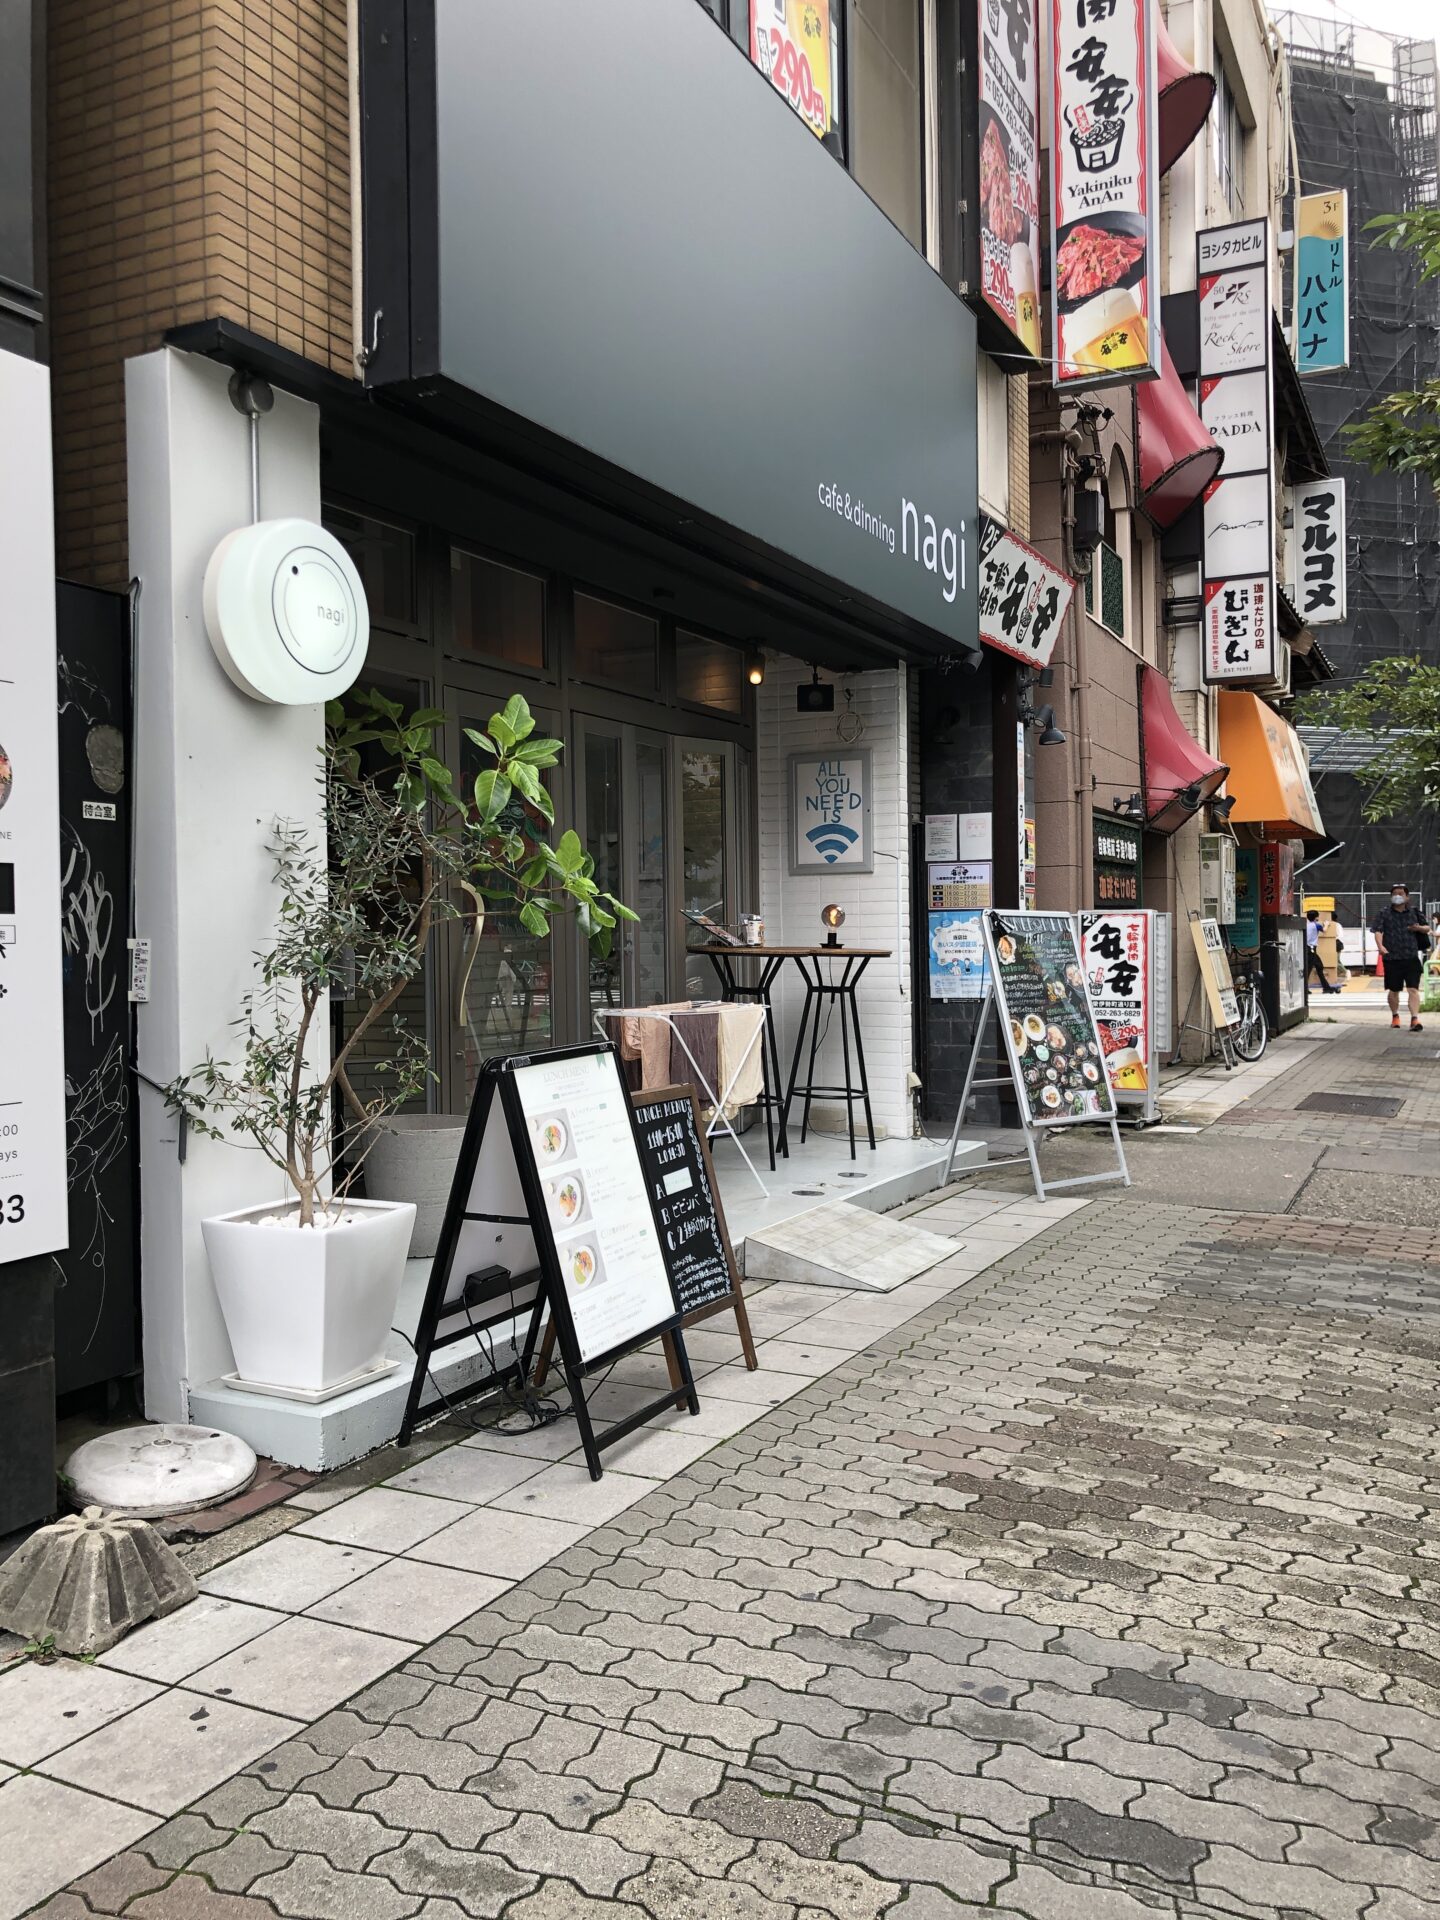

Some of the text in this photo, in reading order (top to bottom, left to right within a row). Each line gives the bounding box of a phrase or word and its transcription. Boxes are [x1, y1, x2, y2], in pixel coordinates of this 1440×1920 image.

[1067, 174, 1133, 199] Yakiniku
[1078, 190, 1124, 210] AnAn
[1323, 200, 1340, 214] 3F
[1202, 235, 1262, 259] ヨシタカビル
[1329, 242, 1343, 289] リトル
[1213, 285, 1225, 296] 50
[1301, 274, 1329, 359] ハバナ
[1204, 322, 1243, 347] Rock
[1227, 332, 1261, 356] Shore
[1204, 383, 1211, 392] 3
[1208, 421, 1262, 438] PADDA
[818, 483, 966, 603] cafe&dinning nagi
[982, 524, 1000, 554] 2F
[1302, 492, 1337, 613] マルコメ
[1209, 585, 1214, 594] 1
[318, 605, 345, 626] nagi
[1254, 583, 1265, 649] 珈琲だけの店
[818, 760, 846, 777] ALL
[816, 777, 850, 795] YOU
[806, 793, 861, 811] NEED
[823, 809, 841, 823] IS
[1083, 914, 1097, 927] 2F
[1090, 923, 1139, 997] 安安
[1092, 1001, 1136, 1009] 栄伊勢町通り店
[1110, 1018, 1132, 1029] カルビ
[635, 1104, 663, 1124] UNCH
[663, 1099, 688, 1117] MENU
[655, 1183, 666, 1201] A
[661, 1198, 671, 1226] B
[667, 1231, 677, 1251] C
